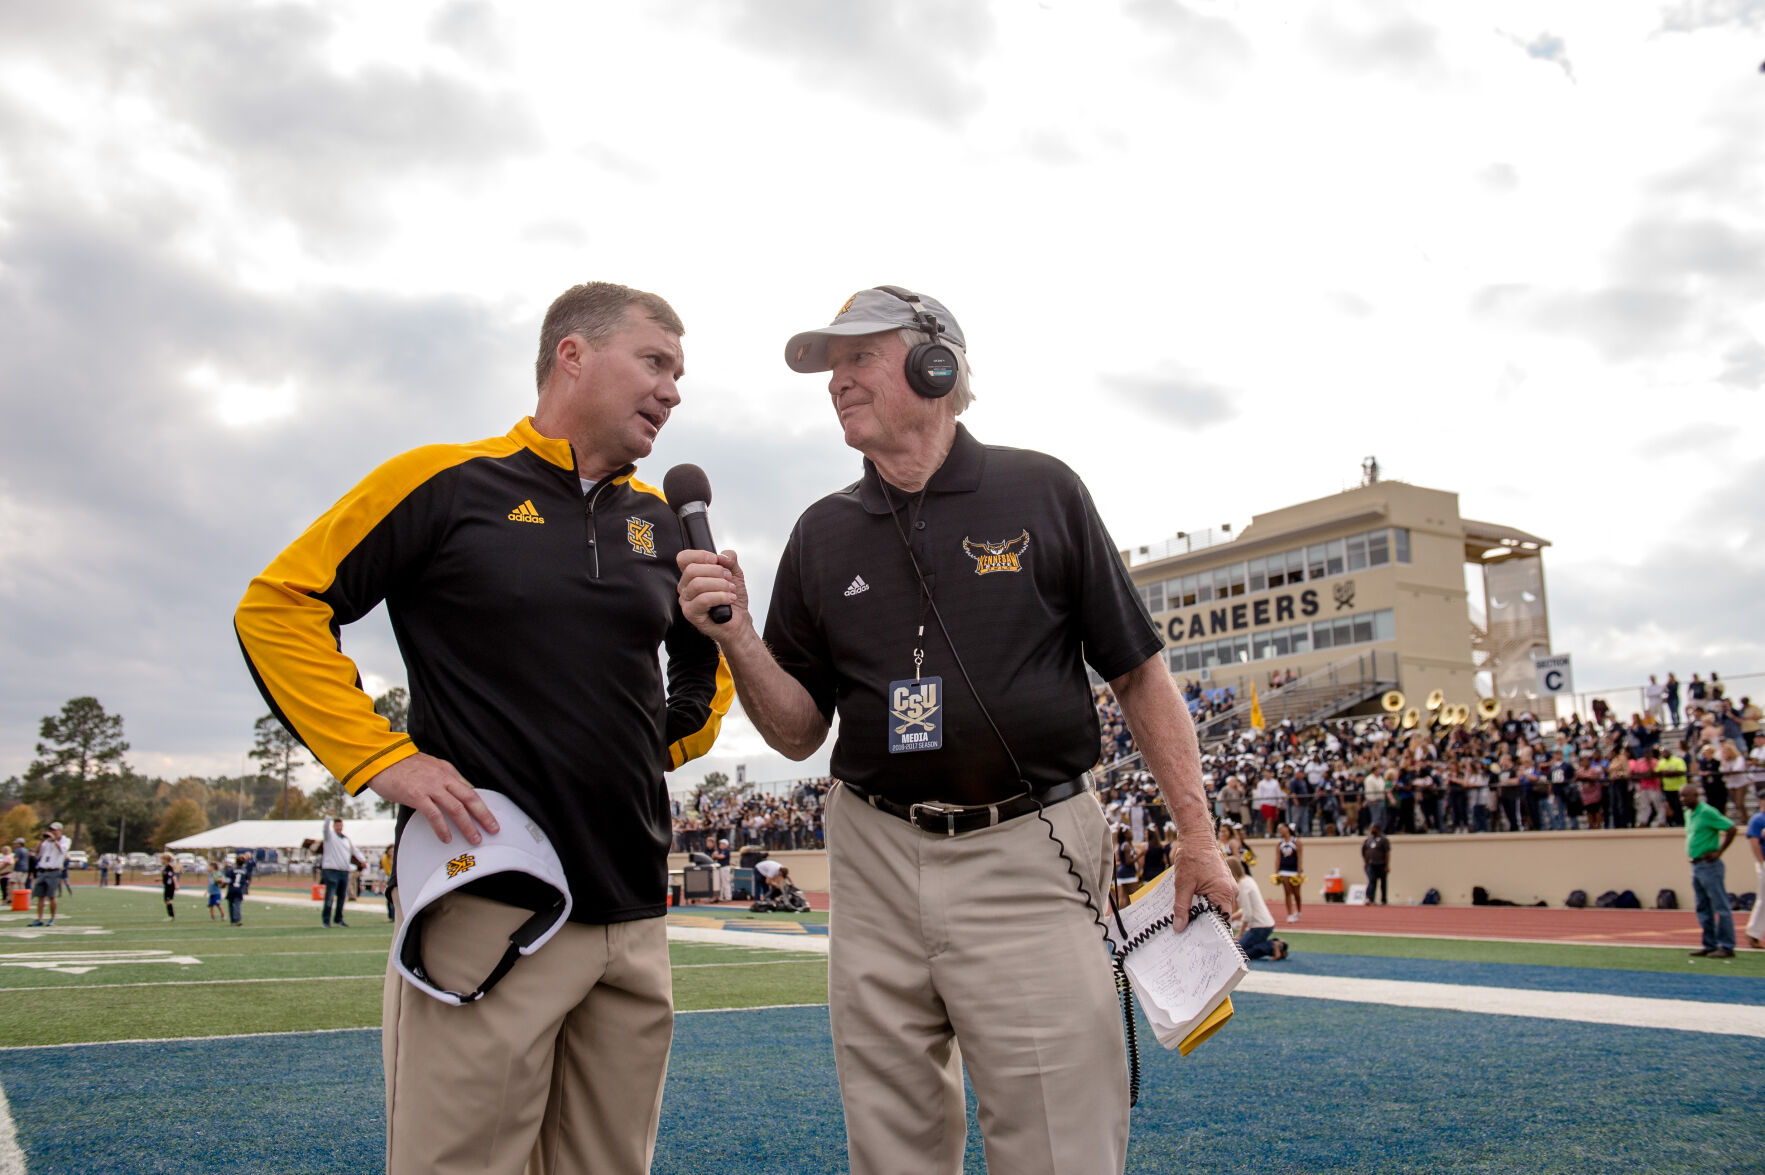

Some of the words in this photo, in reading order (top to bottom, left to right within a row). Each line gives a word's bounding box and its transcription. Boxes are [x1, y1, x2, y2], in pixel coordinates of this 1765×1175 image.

[508, 513, 545, 524] adidas
[977, 552, 1019, 571] KENNESAW
[844, 584, 870, 597] adidas
[1545, 670, 1563, 691] C
[893, 684, 937, 719] CSU
[901, 732, 929, 744] MEDIA
[918, 741, 938, 749] SEASON
